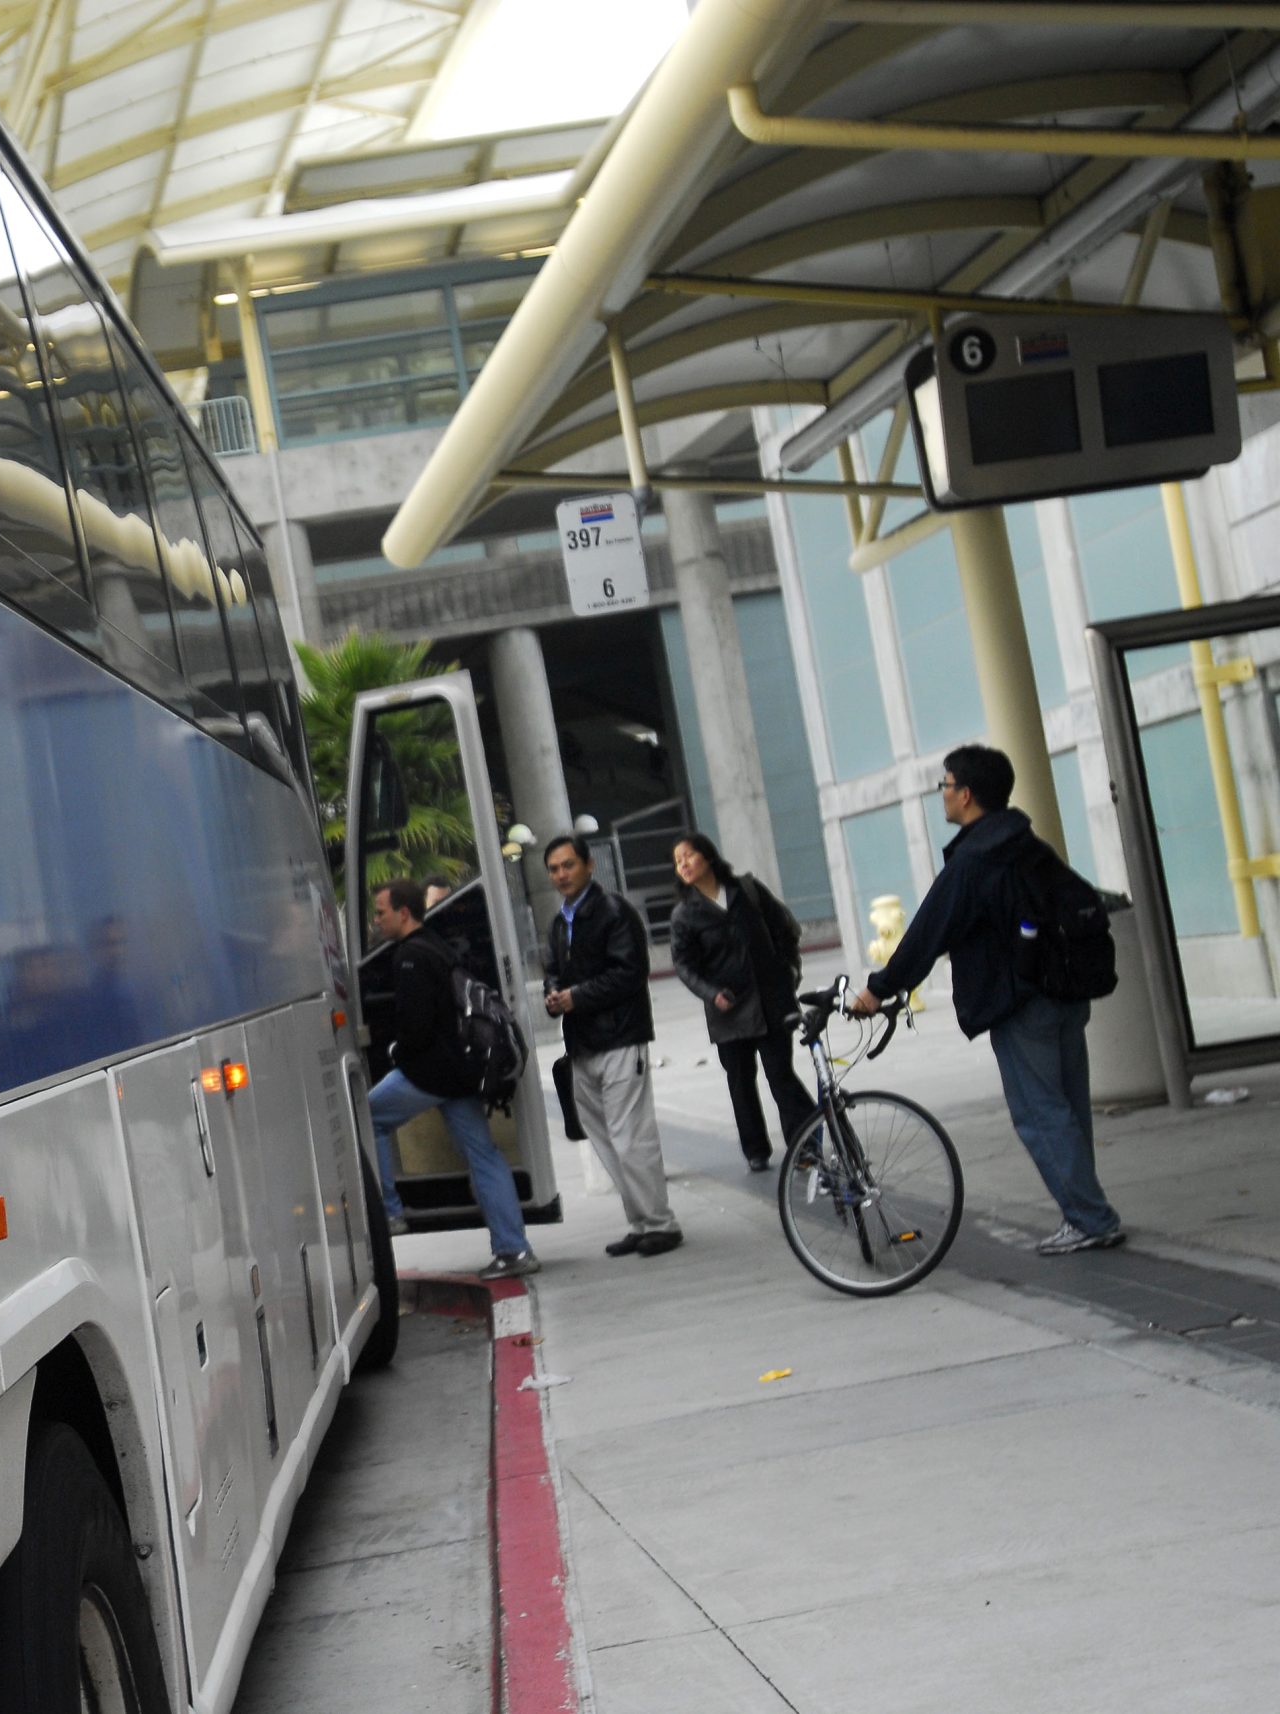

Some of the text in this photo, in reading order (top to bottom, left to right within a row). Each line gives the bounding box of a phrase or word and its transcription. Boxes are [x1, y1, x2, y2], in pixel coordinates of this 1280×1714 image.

[962, 335, 983, 367] 6
[566, 526, 601, 550] 397
[602, 578, 615, 598] 6
